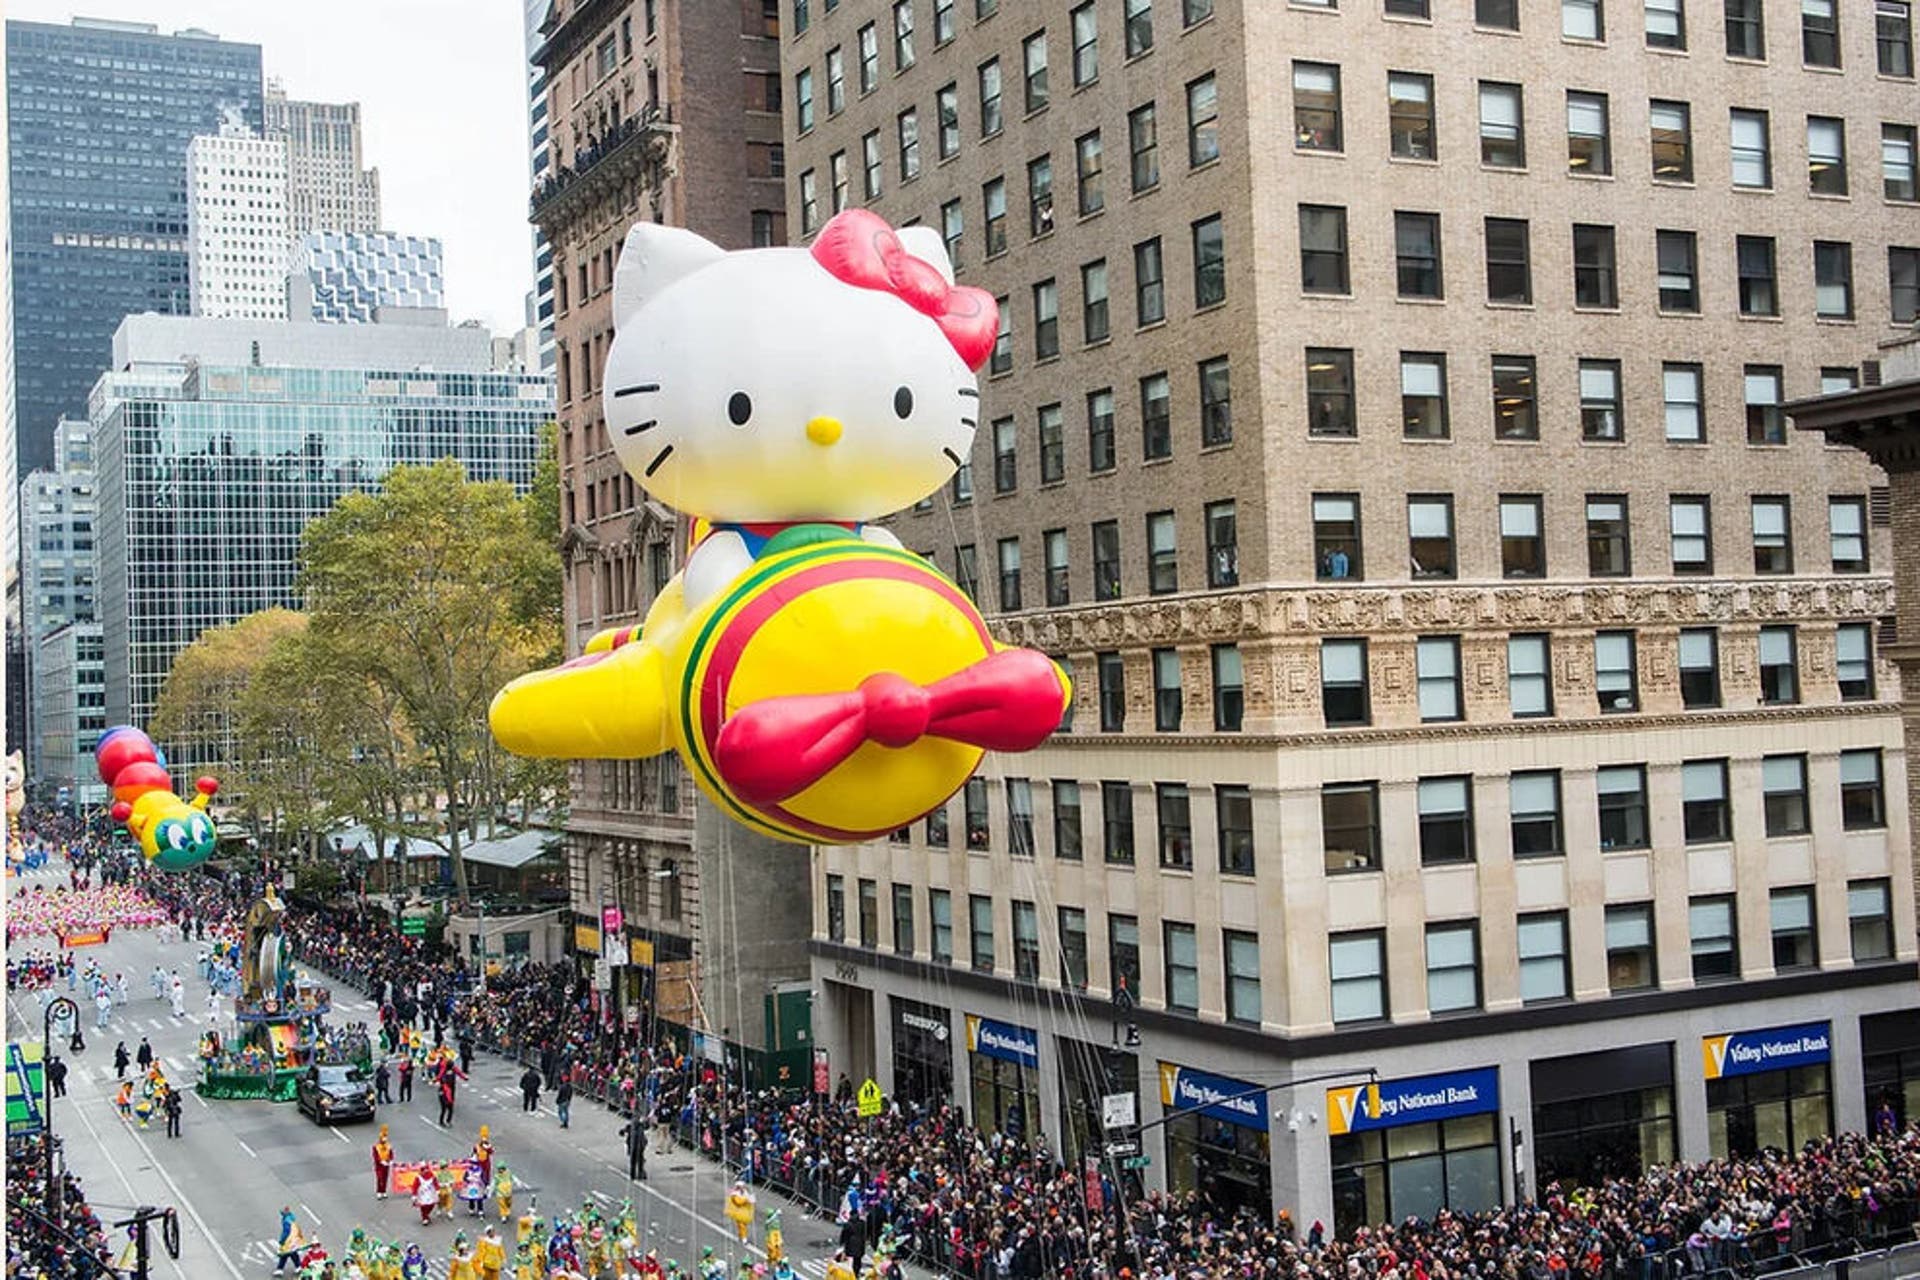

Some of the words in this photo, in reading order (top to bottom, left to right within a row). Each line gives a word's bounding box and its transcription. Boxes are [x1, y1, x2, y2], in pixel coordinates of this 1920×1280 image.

[1730, 1043, 1762, 1064] Valley
[1762, 1039, 1802, 1057] National
[1802, 1036, 1829, 1052] Bank
[1179, 1078, 1204, 1104] Valley
[1399, 1088, 1446, 1111] National
[1447, 1085, 1478, 1103] Bank
